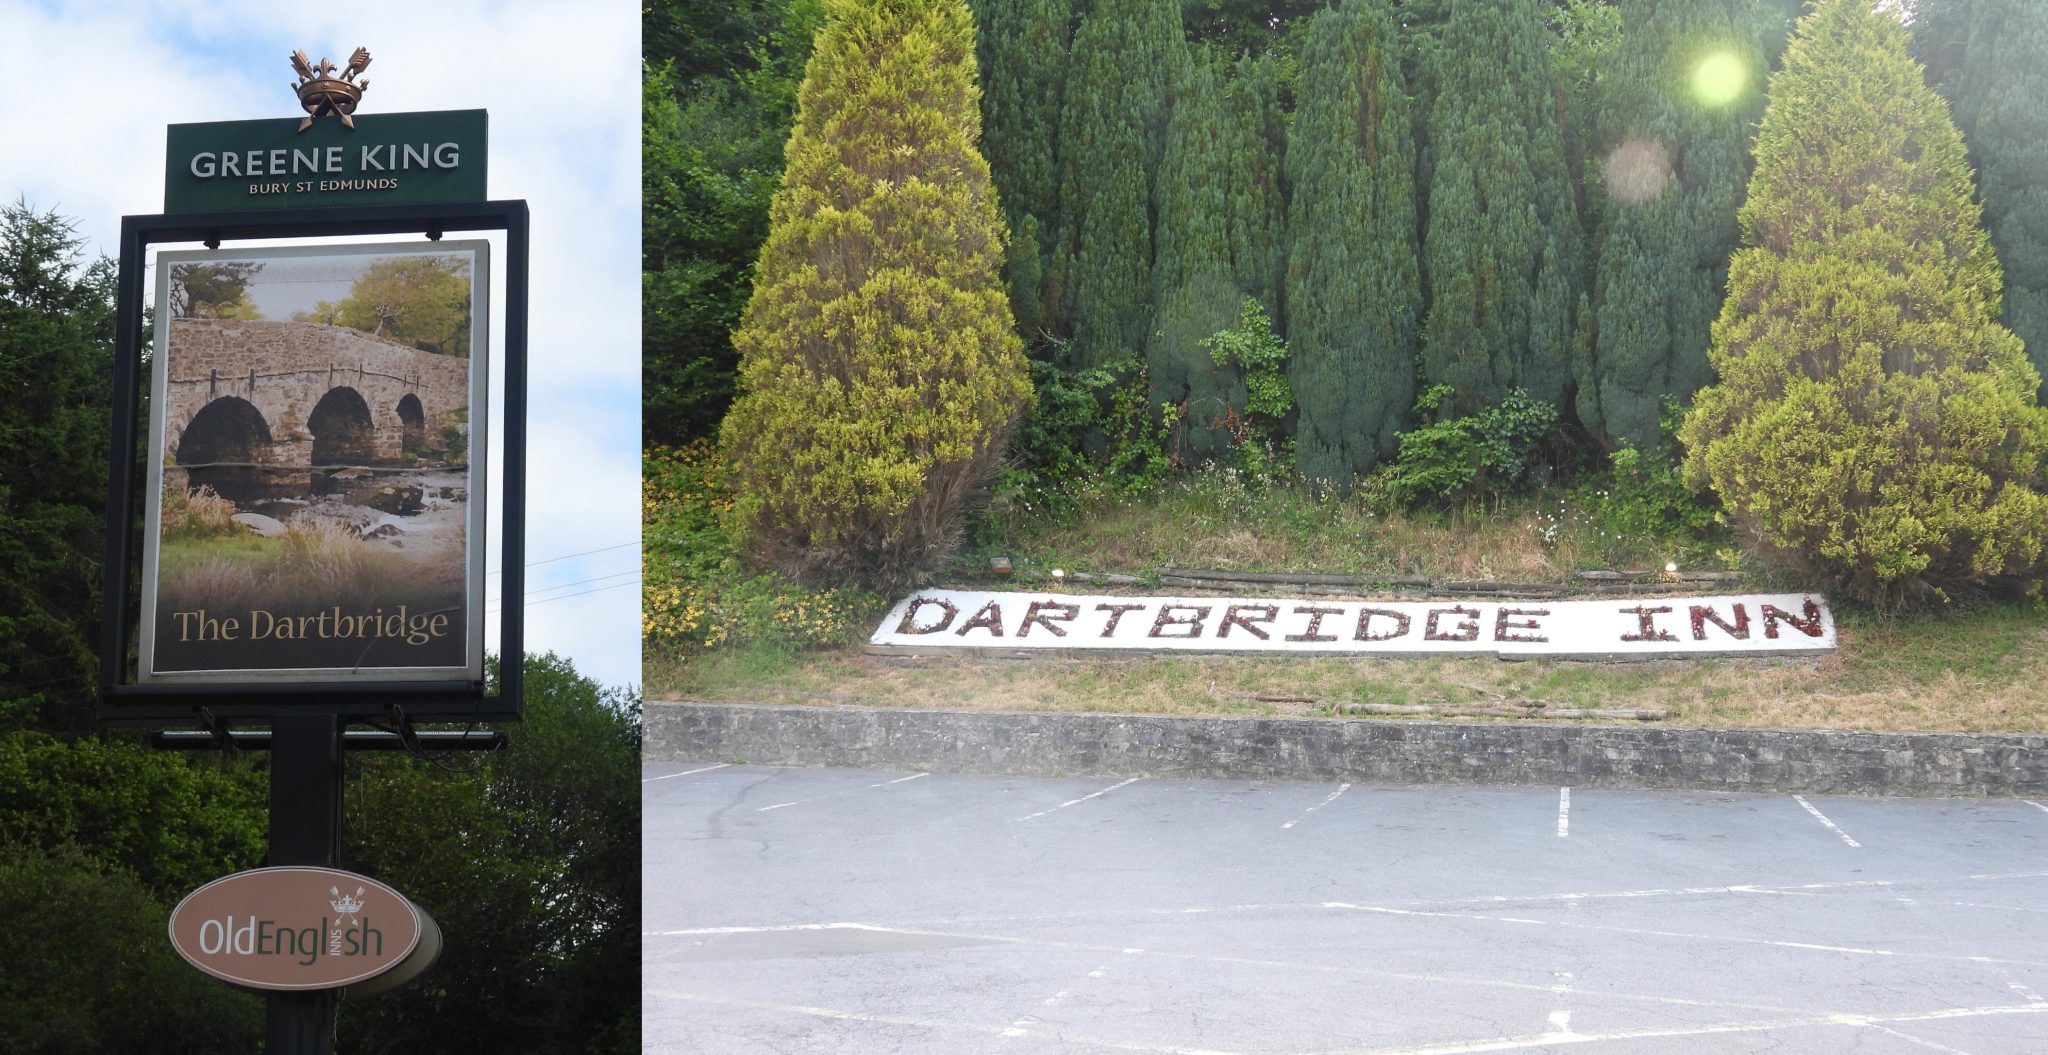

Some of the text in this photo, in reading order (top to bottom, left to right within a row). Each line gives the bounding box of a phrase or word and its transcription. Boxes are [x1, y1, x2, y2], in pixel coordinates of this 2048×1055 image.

[190, 142, 460, 178] GREENE KING
[249, 178, 398, 195] BURY ST EDMUNDS
[173, 605, 449, 645] The Dartbridge
[894, 594, 1824, 644] DARTBRIDGE INN
[330, 929, 342, 956] INNS
